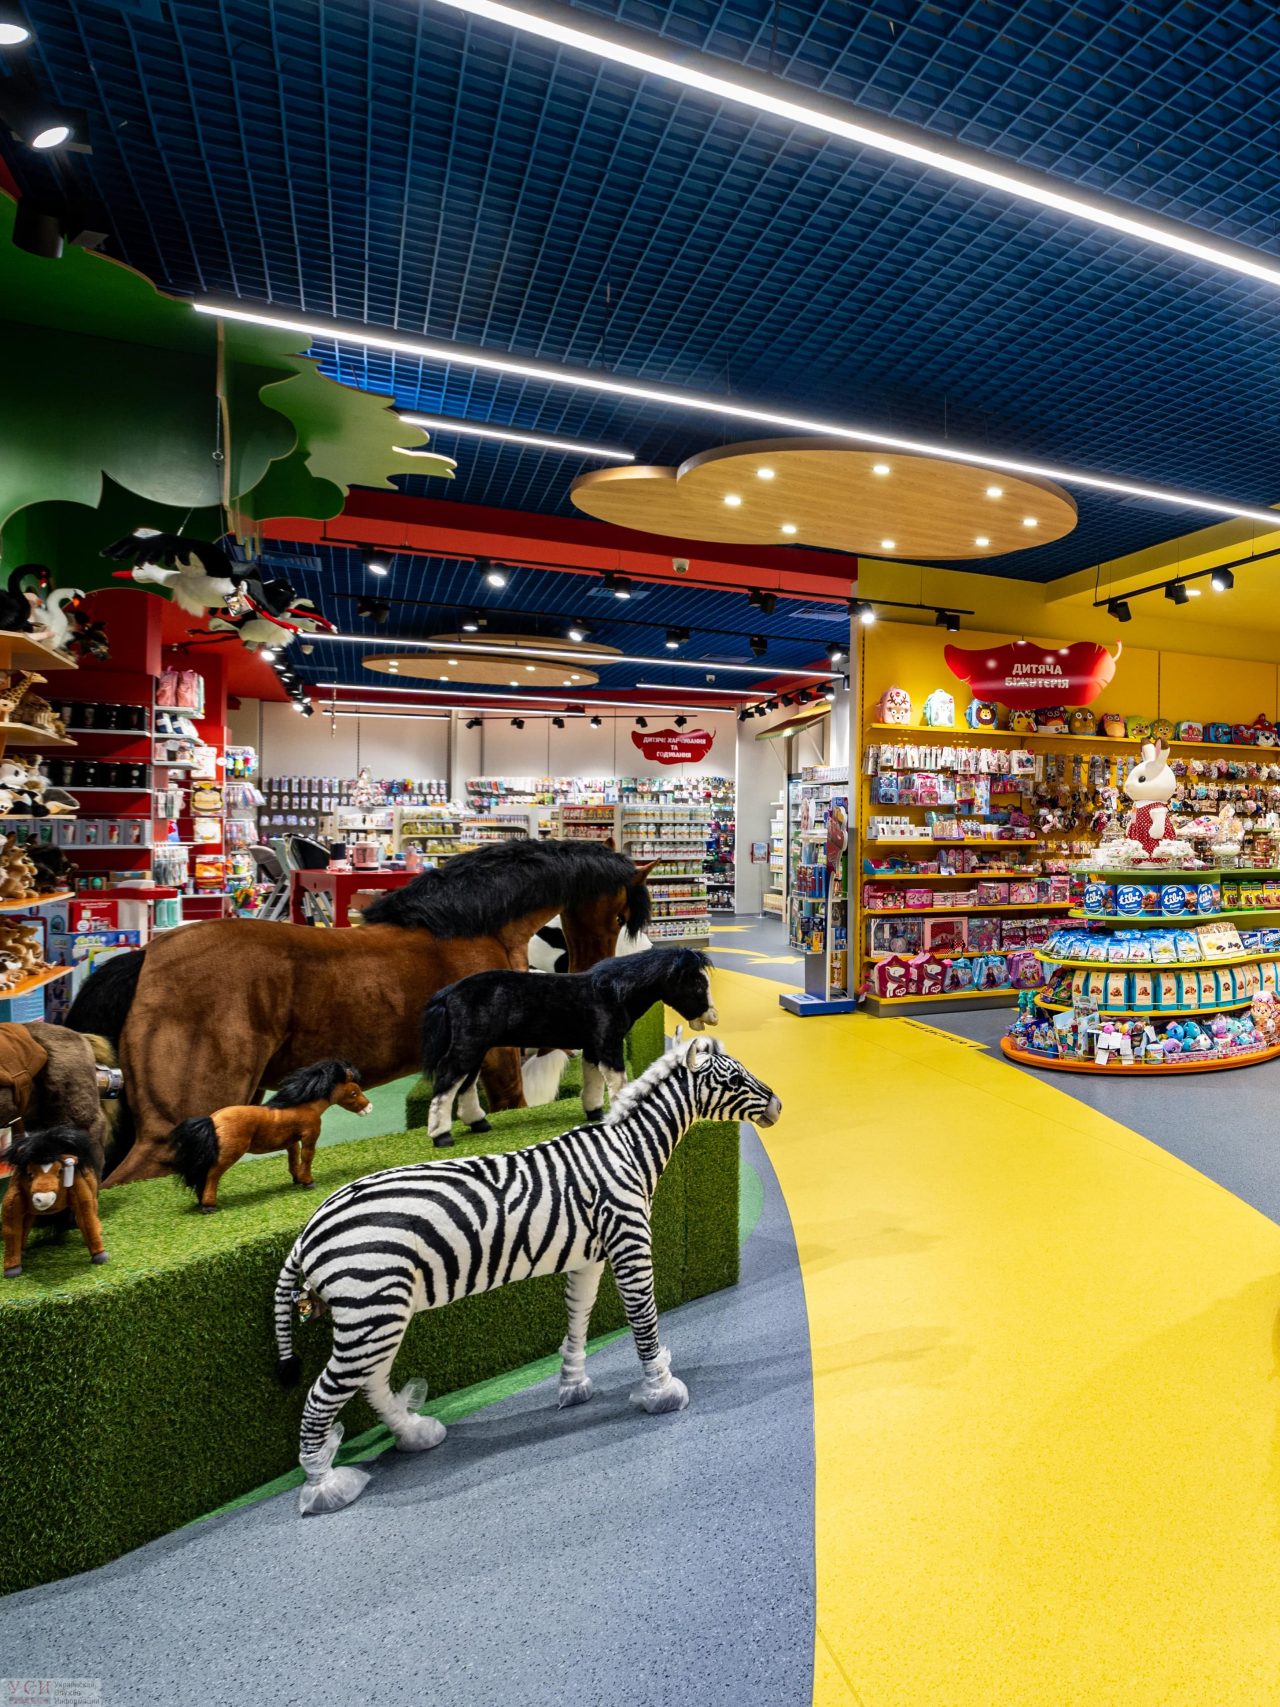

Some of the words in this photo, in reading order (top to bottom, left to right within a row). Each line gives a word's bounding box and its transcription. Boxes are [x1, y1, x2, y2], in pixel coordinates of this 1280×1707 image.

[1012, 663, 1062, 676] ДИТЯЧА
[1005, 677, 1069, 689] БІЖУТЕРІЯ
[656, 751, 692, 759] ГОДУВАННЯ
[1085, 891, 1102, 906] tibi
[1118, 891, 1142, 906] tibi
[1163, 891, 1186, 906] tibi
